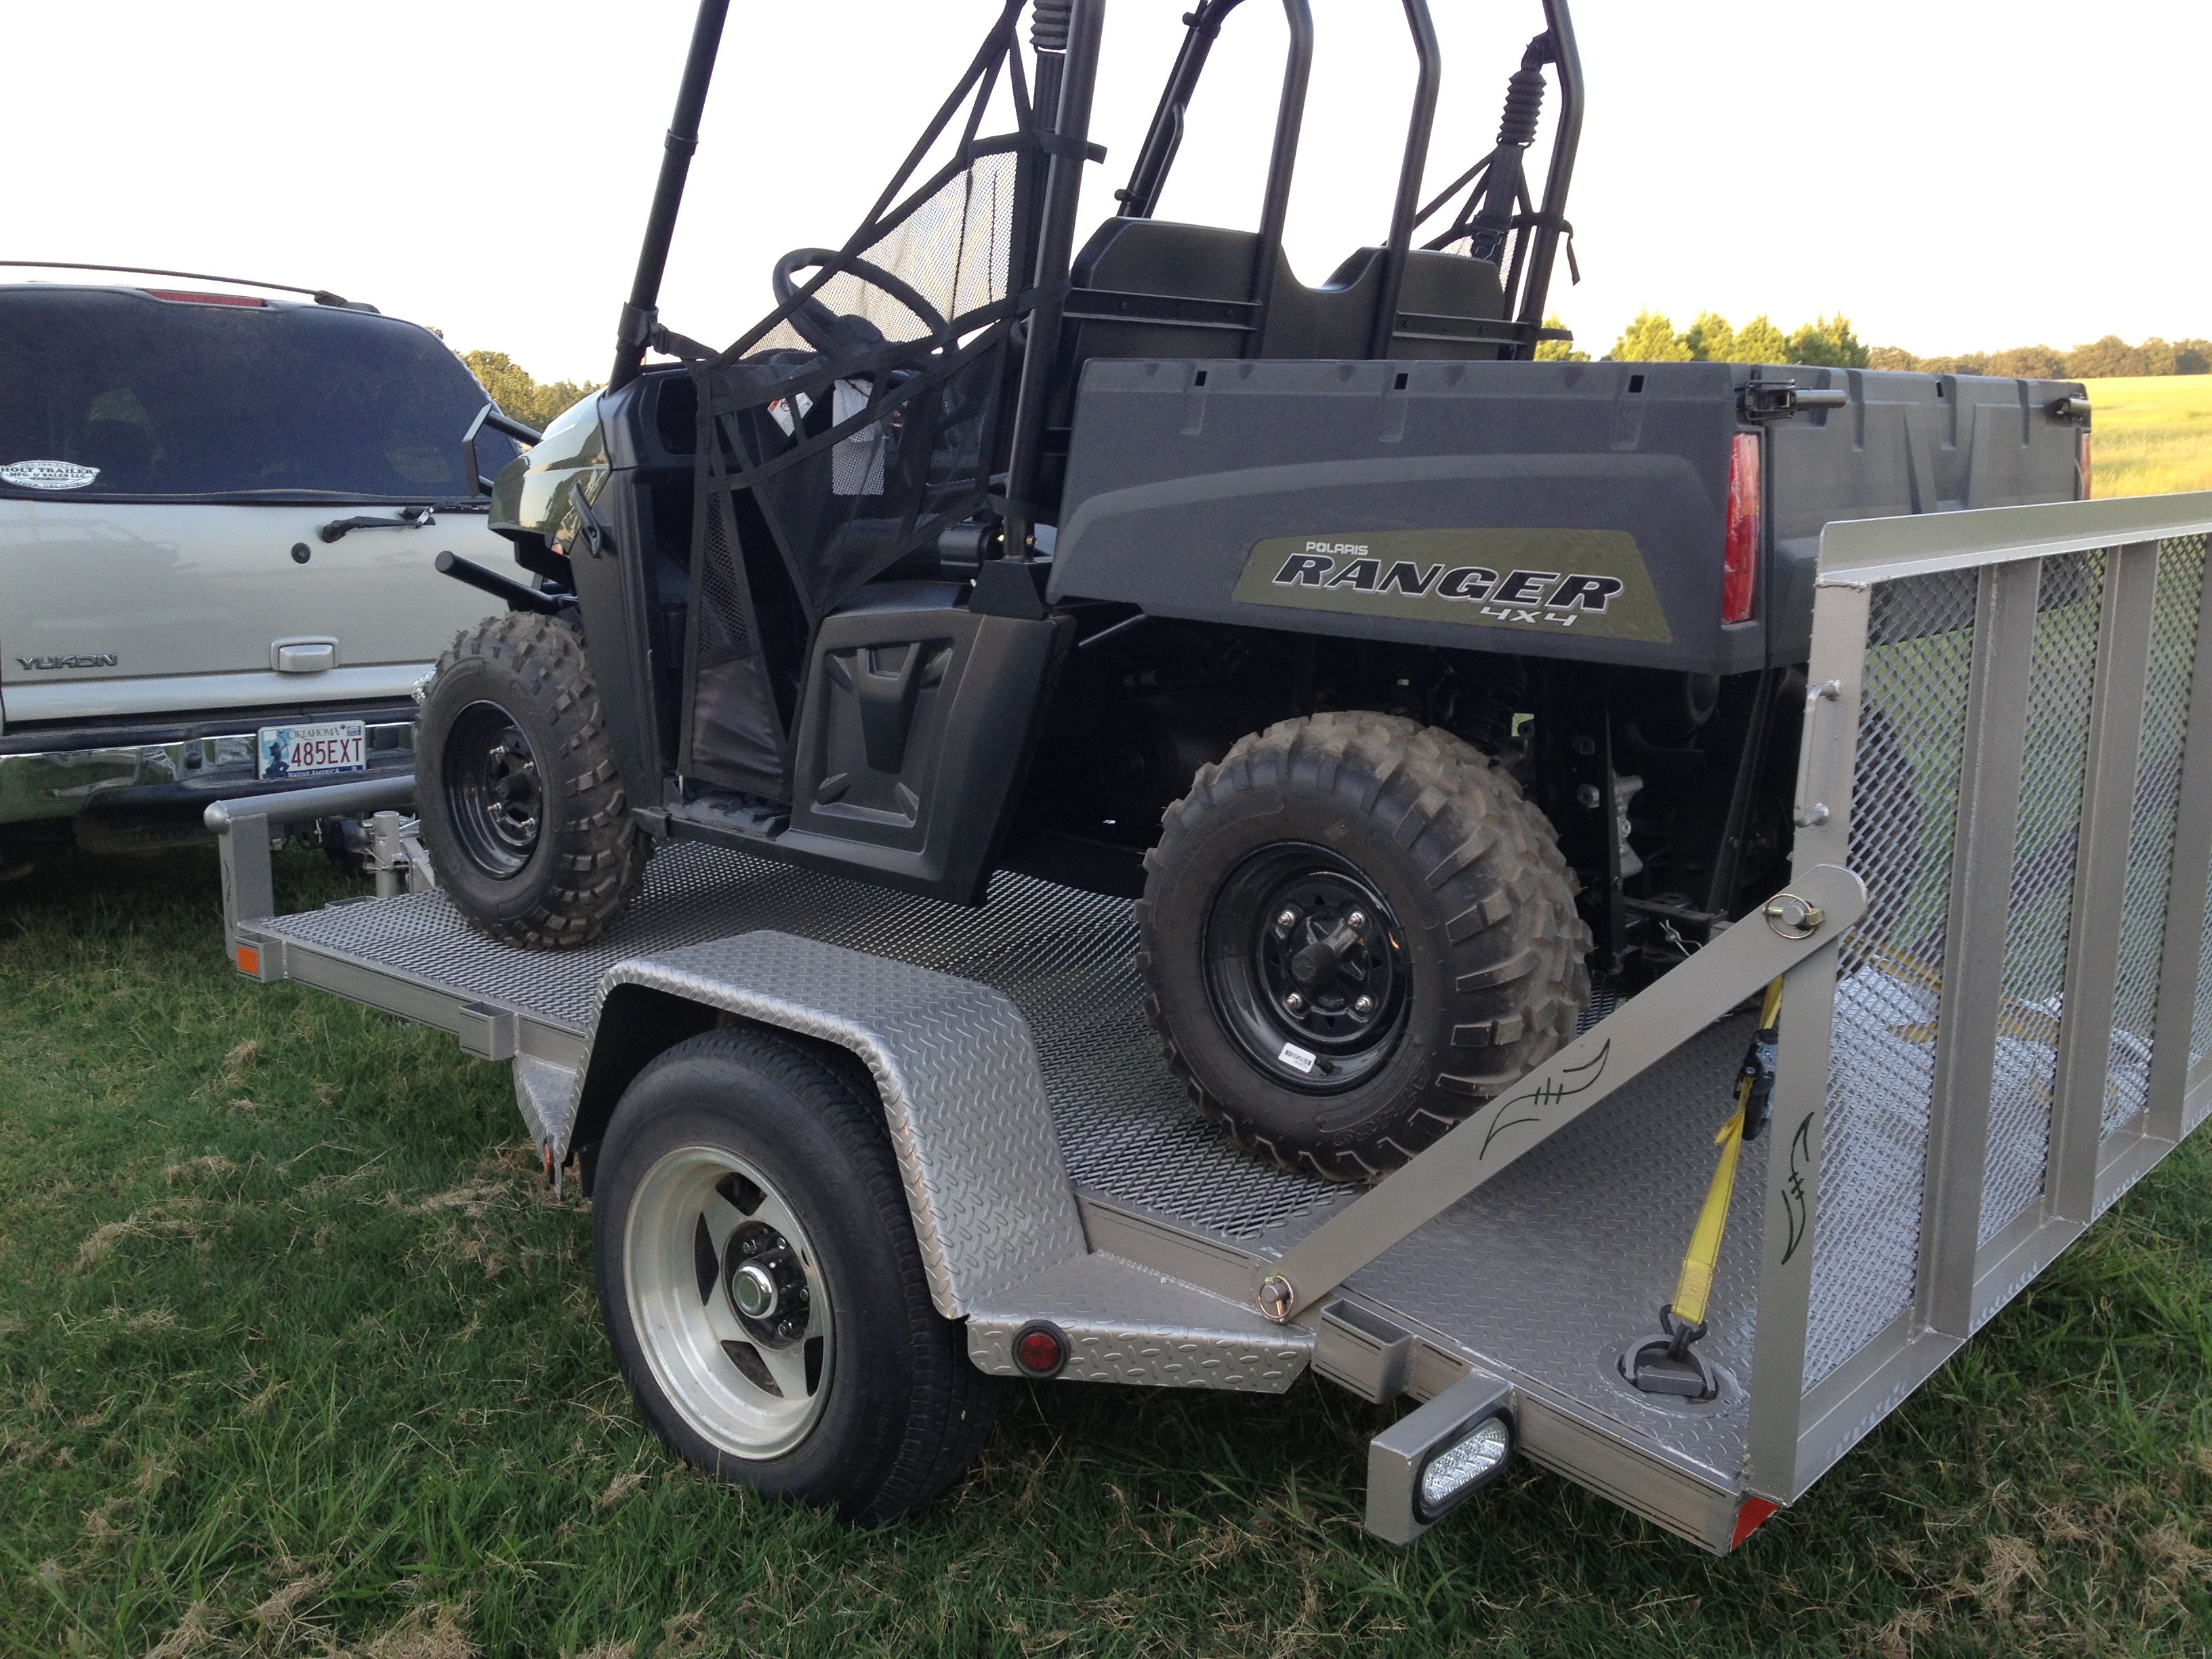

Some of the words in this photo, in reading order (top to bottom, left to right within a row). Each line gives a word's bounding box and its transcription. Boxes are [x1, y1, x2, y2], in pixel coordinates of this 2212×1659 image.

[1305, 541, 1369, 556] POLARIS
[1272, 553, 1626, 615] RANGER
[16, 653, 118, 670] YUKON
[287, 727, 340, 740] OKLAHOMA
[291, 738, 362, 767] 485EXT
